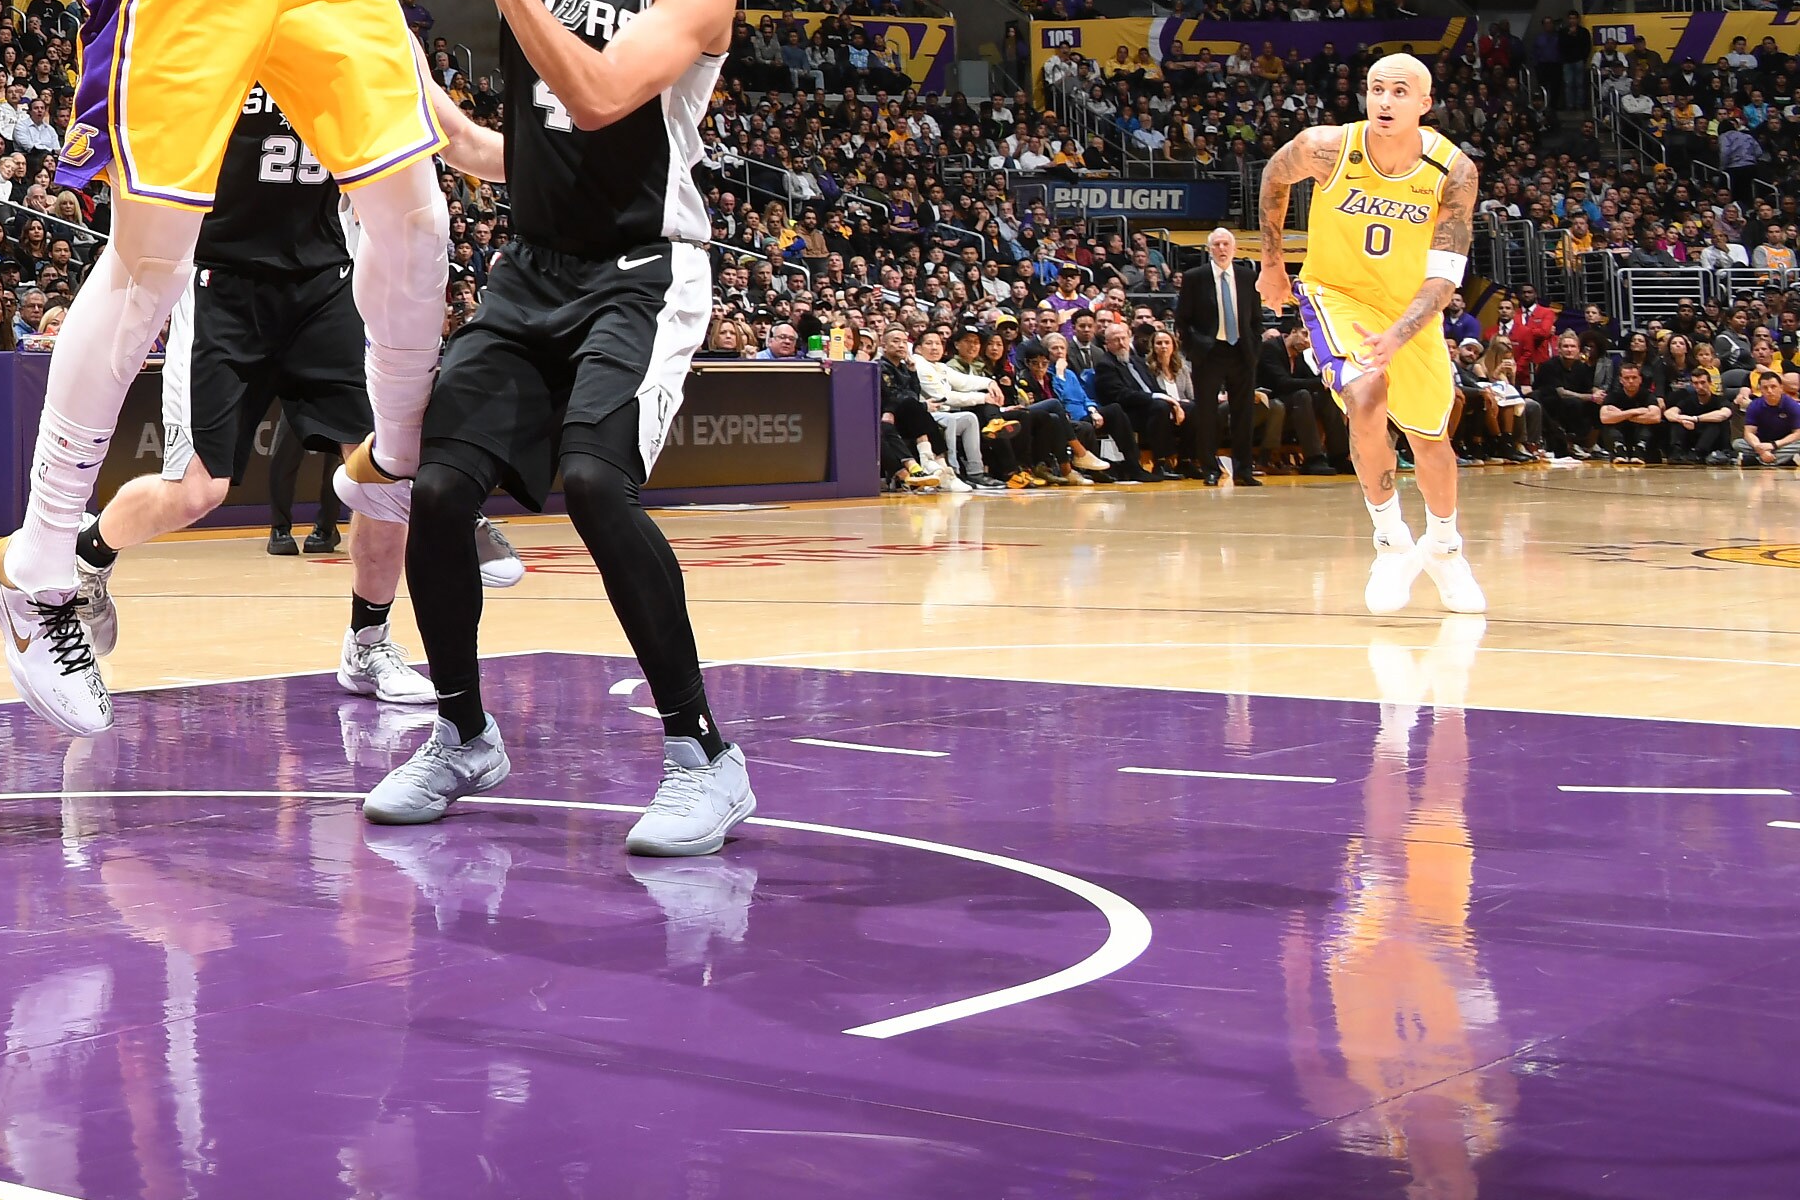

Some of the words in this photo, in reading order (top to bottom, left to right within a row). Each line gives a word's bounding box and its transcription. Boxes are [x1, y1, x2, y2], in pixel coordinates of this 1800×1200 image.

[258, 134, 330, 185] 25
[1054, 187, 1108, 209] BUD
[1110, 188, 1184, 210] LIGHT
[1335, 188, 1431, 224] LAKERS
[1364, 223, 1392, 256] 0
[692, 413, 804, 446] EXPRESS
